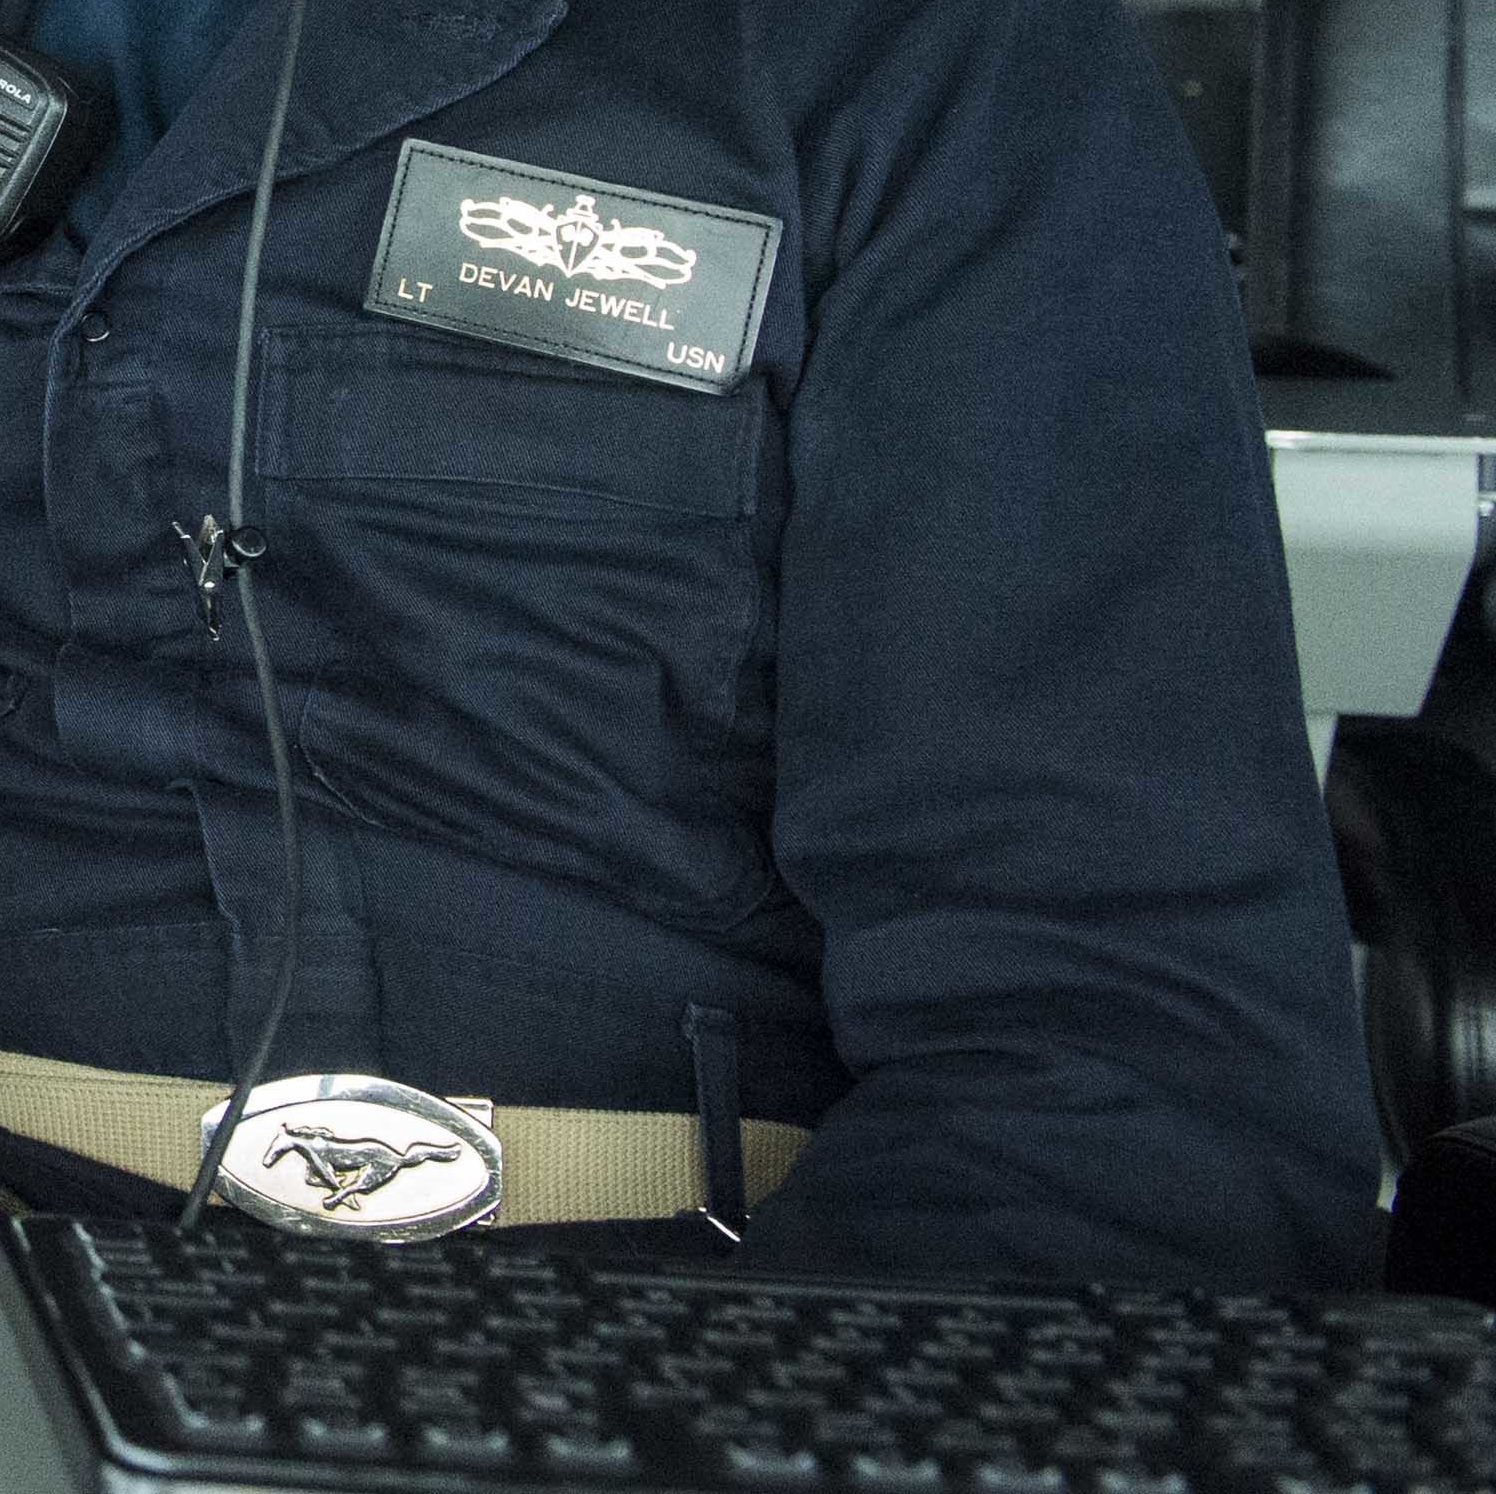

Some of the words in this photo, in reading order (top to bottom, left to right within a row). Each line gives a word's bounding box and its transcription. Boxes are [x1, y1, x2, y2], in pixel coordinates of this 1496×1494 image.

[397, 277, 434, 304] LT
[459, 261, 555, 302] DEVAN
[565, 288, 676, 331] JEWELL
[666, 341, 726, 374] USN
